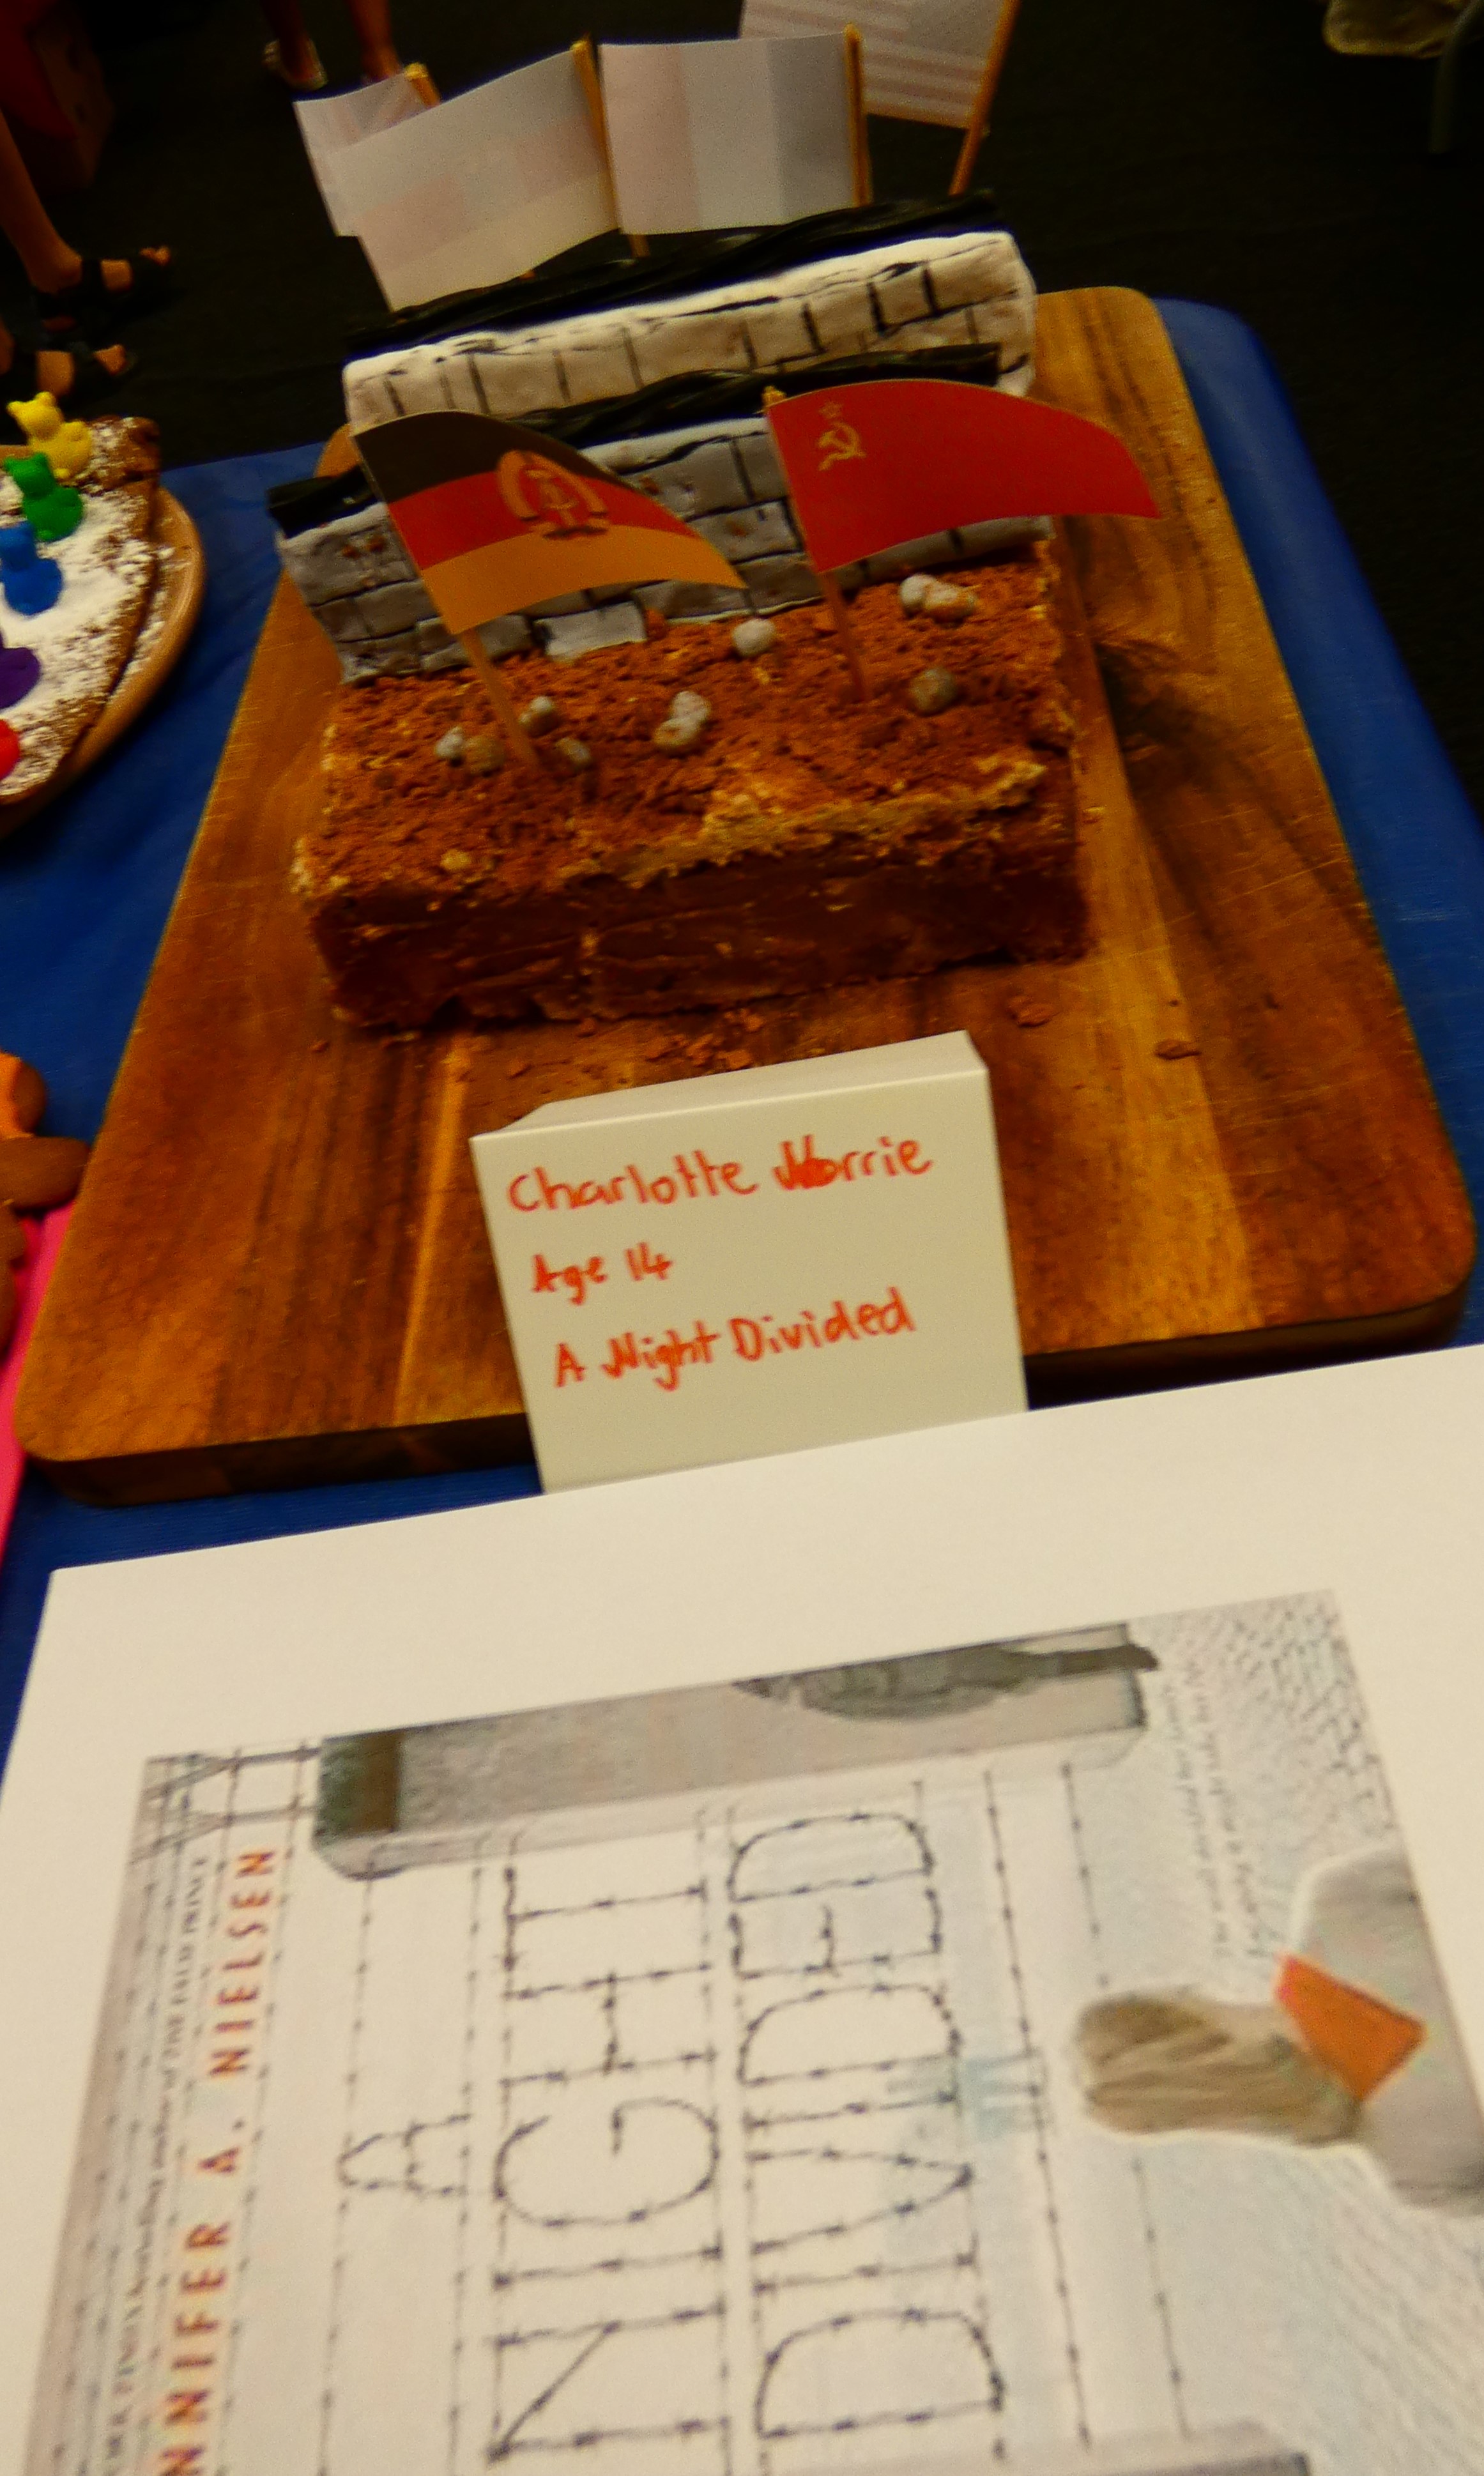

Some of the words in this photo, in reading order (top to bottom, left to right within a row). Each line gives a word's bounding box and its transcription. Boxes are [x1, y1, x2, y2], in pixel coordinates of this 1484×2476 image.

[507, 1149, 759, 1212] Charlotte
[531, 1253, 607, 1306] Age
[625, 1242, 674, 1281] 14
[553, 1341, 586, 1389] A
[602, 1320, 721, 1392] Night
[728, 1287, 917, 1362] Divided
[209, 1851, 276, 2081] NIELSEN
[197, 2117, 247, 2175] A.
[337, 2113, 471, 2197] A
[486, 1865, 731, 2463] NIGHT
[726, 1810, 1006, 2440] DIVIDED
